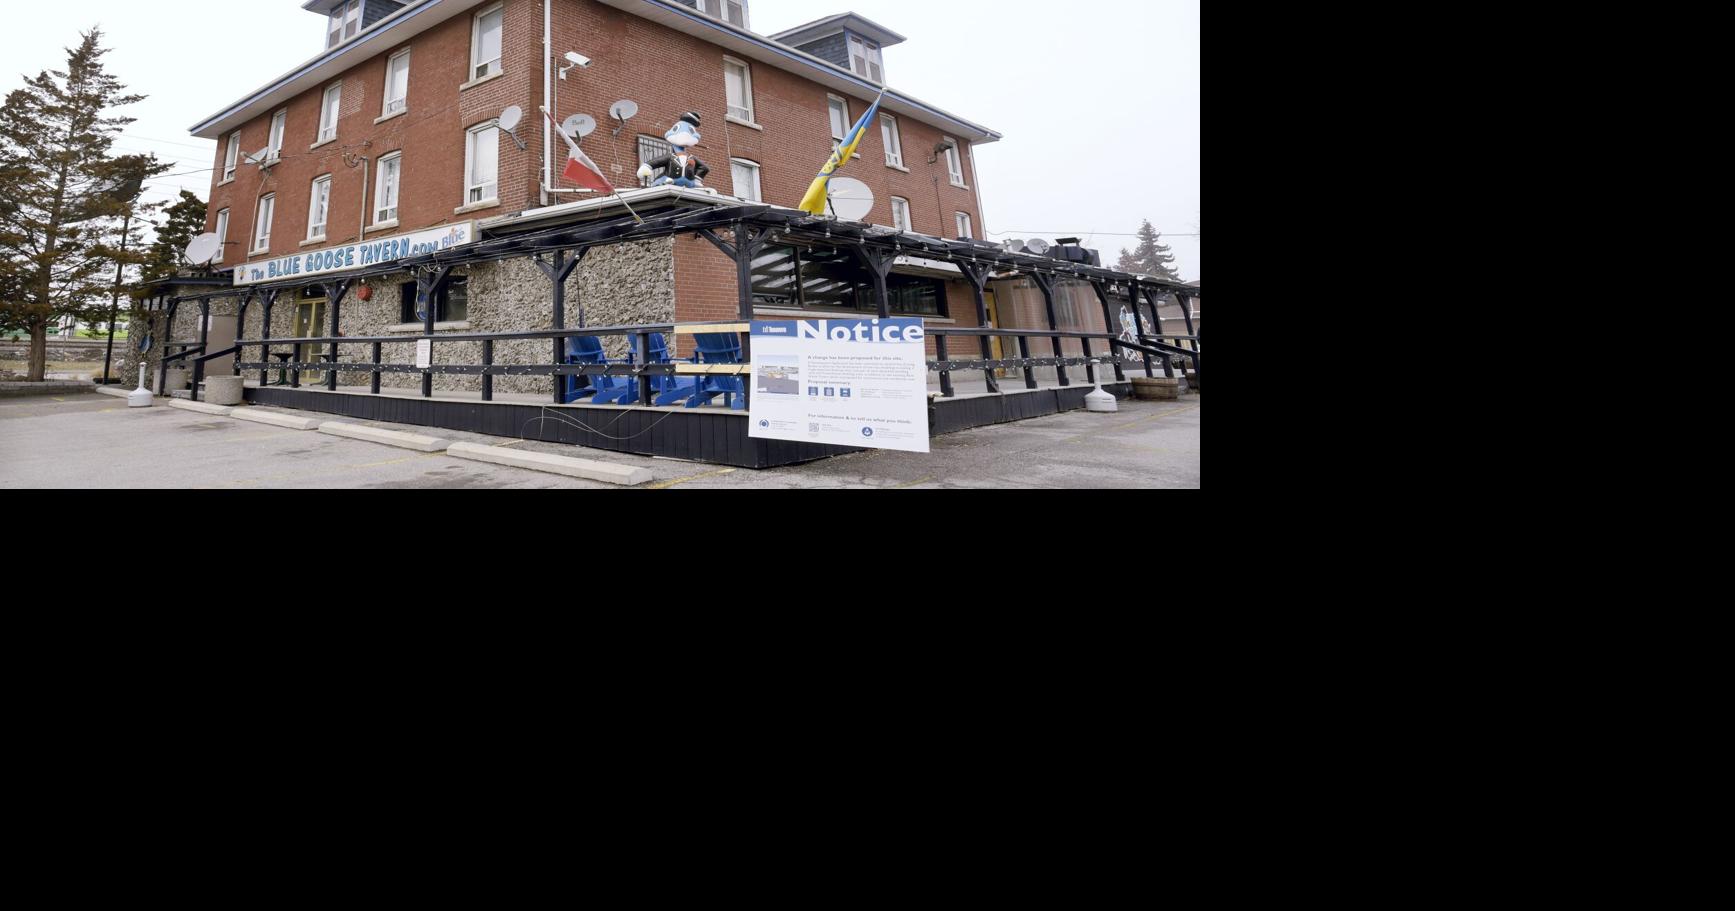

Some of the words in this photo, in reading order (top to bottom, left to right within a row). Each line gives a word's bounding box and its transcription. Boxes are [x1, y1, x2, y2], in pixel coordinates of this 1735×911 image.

[442, 230, 465, 249] Blue
[251, 268, 264, 280] The
[268, 257, 301, 278] BLUE
[305, 247, 355, 272] GOOSE
[797, 318, 924, 343] Notice
